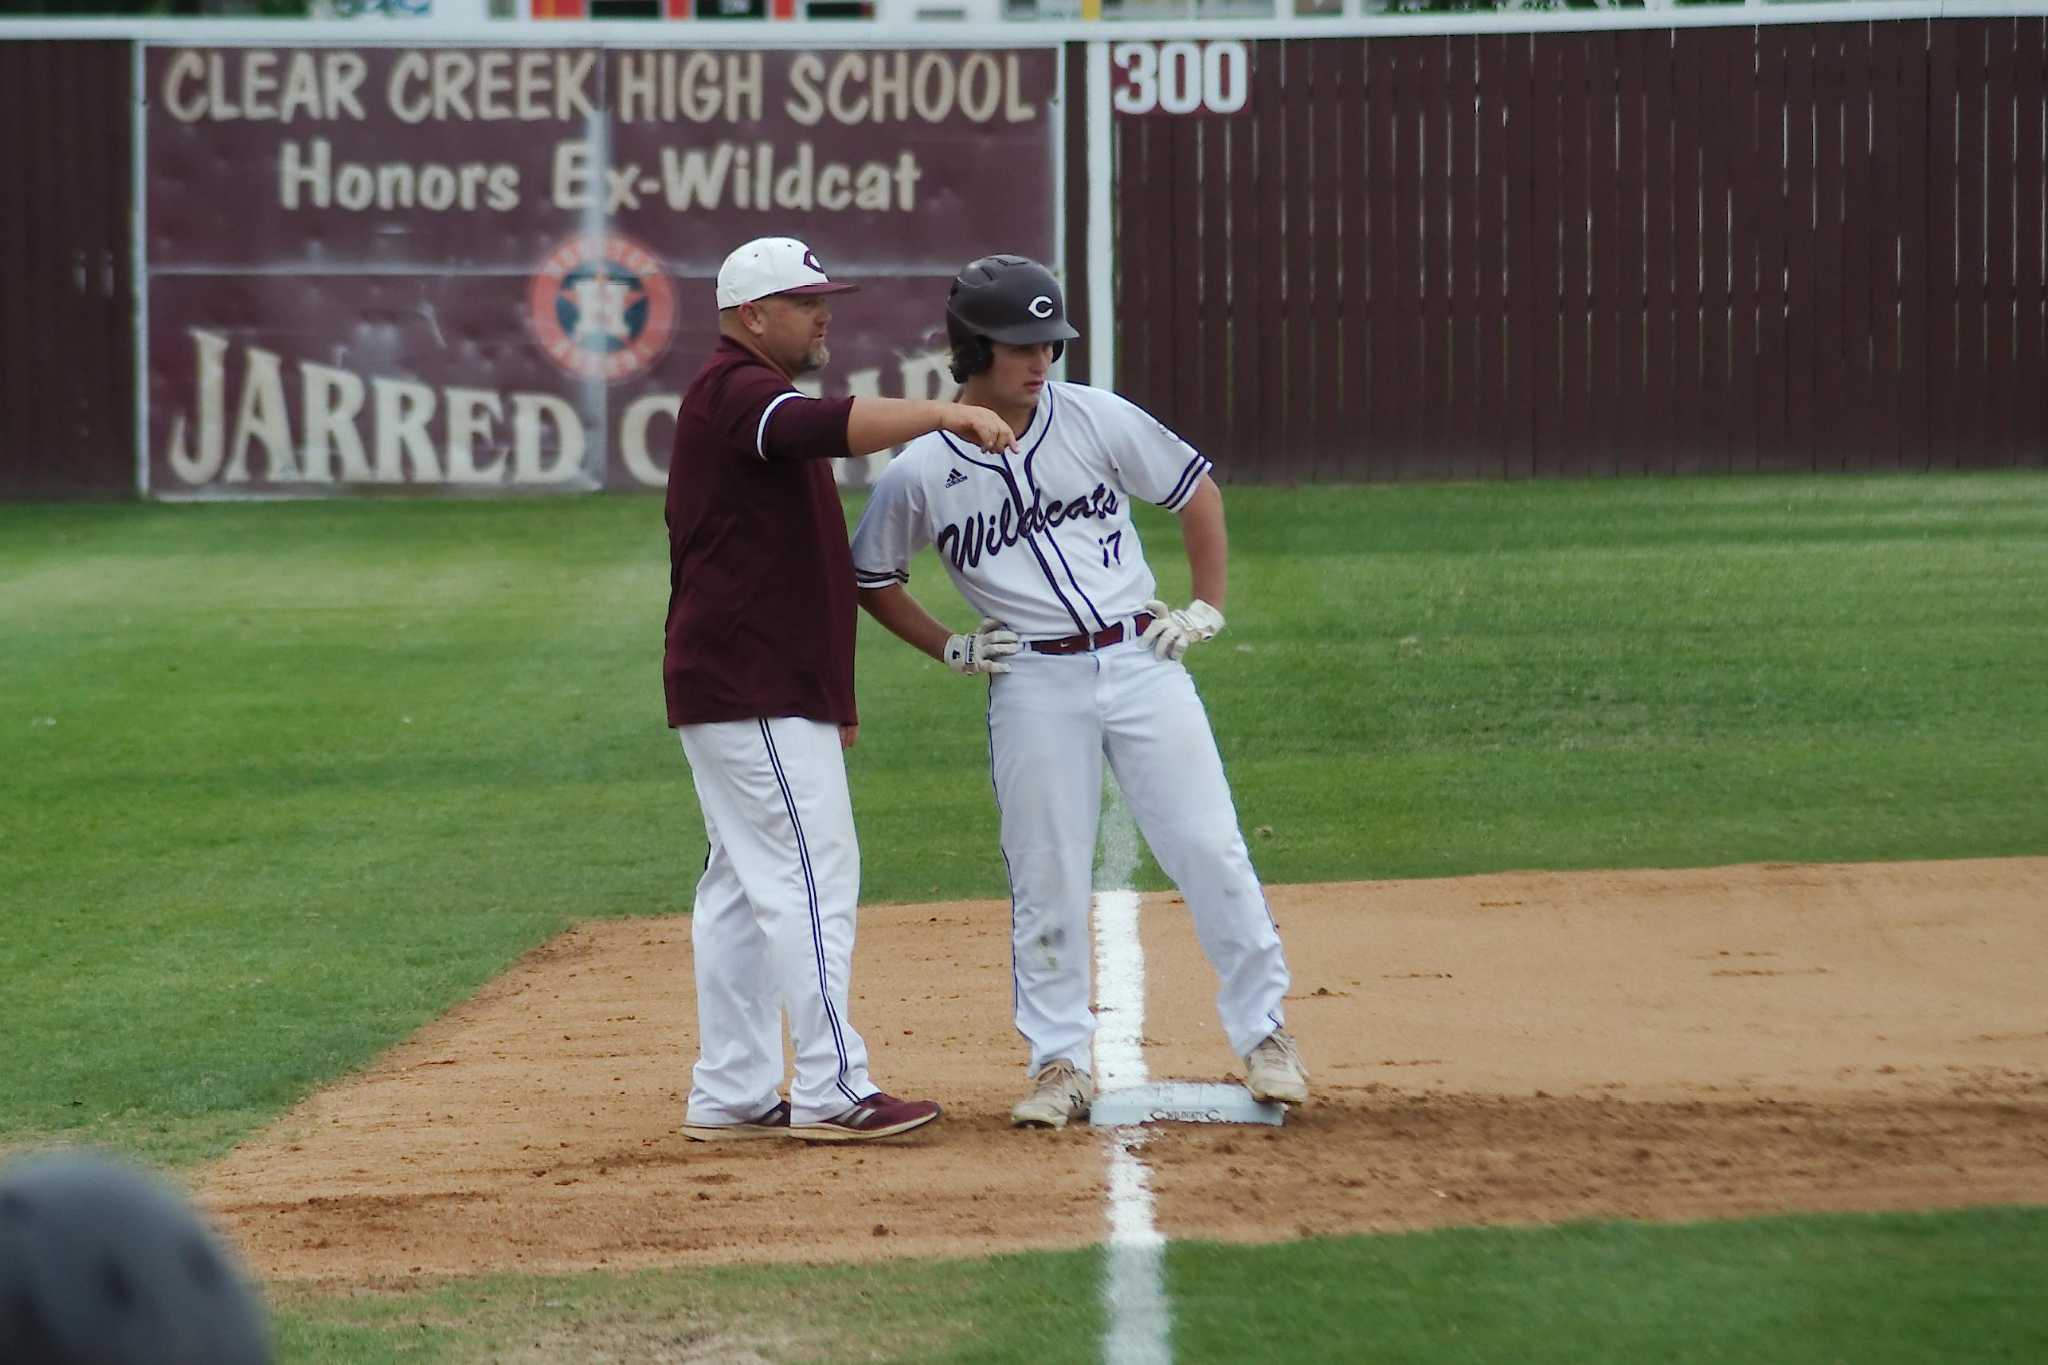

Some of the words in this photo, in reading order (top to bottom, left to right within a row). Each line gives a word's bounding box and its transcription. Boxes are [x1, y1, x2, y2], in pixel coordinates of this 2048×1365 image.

[164, 50, 367, 122] CLEAR
[389, 50, 594, 123] CREEK
[619, 51, 763, 122] HIGH
[786, 52, 1036, 124] SCHOOL
[1113, 41, 1248, 115] 300
[280, 140, 520, 210] Honors
[1027, 294, 1054, 319] C
[168, 328, 586, 485] JARRED
[938, 483, 1119, 574] Wildcats
